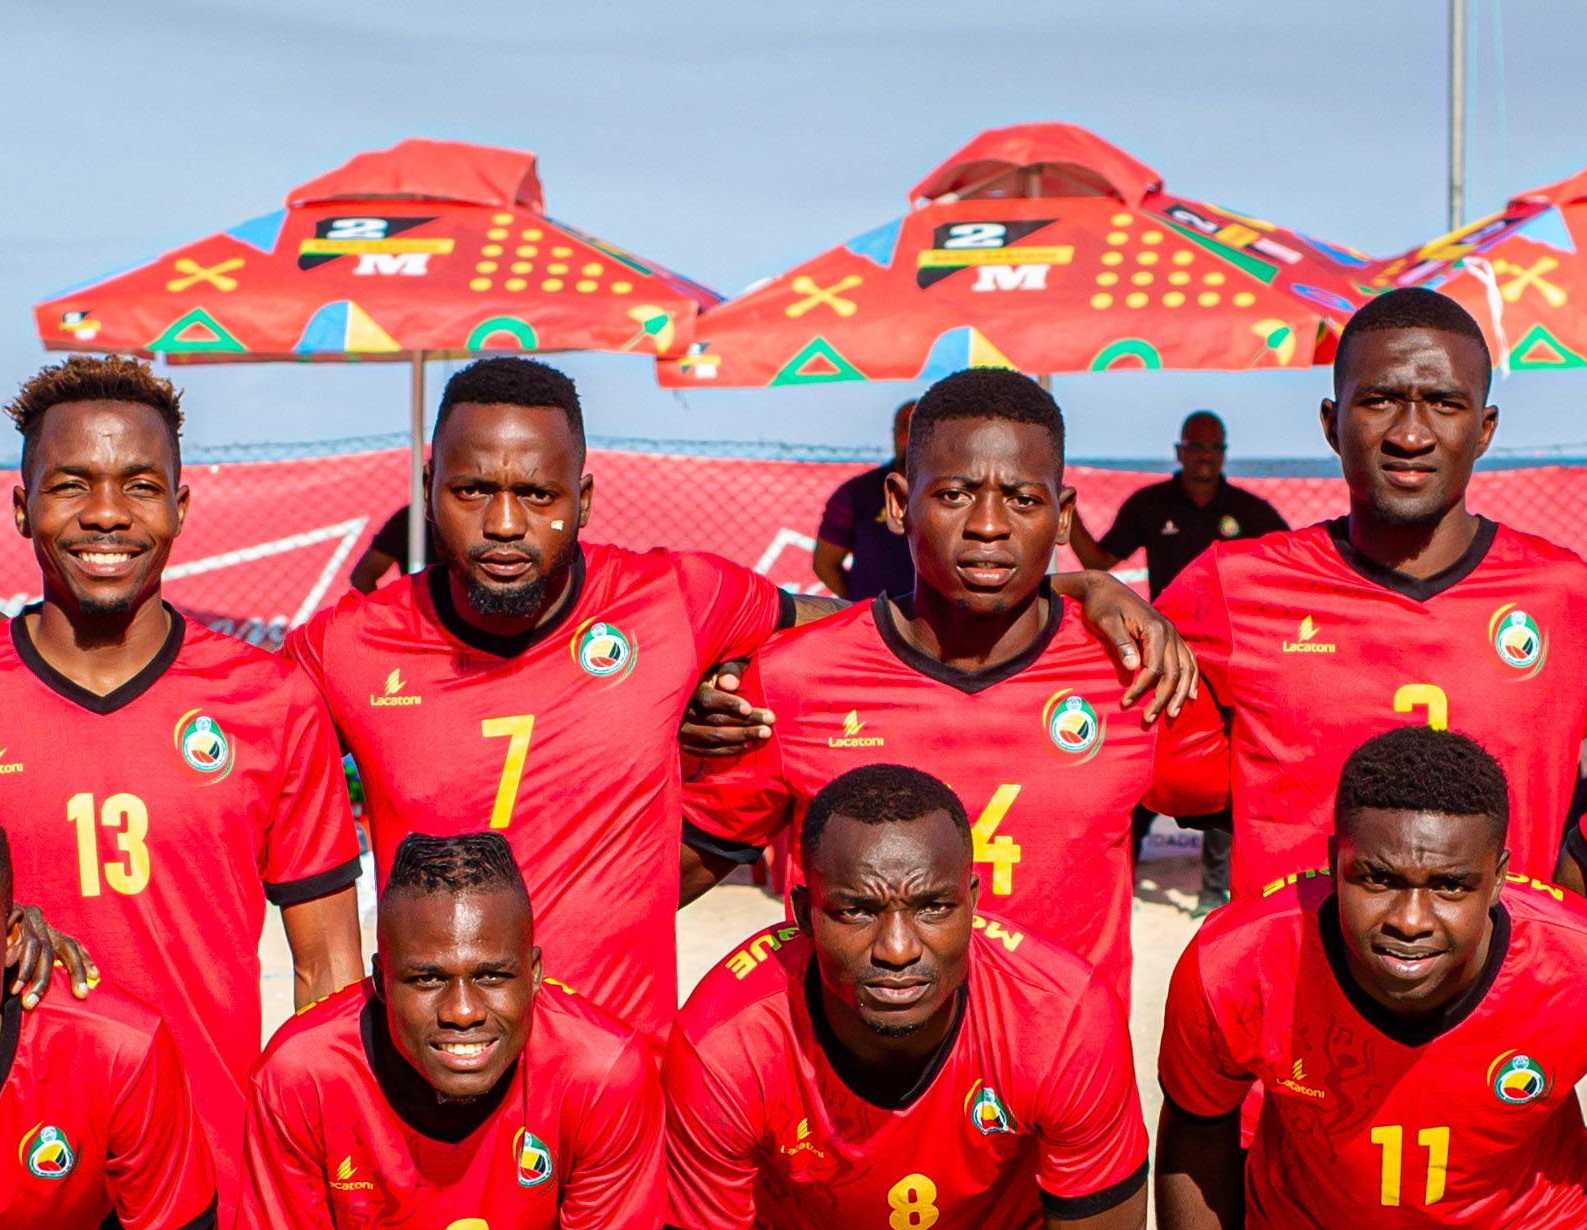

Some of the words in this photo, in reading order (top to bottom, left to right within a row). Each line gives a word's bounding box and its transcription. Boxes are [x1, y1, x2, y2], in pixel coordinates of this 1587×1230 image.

[326, 218, 388, 240] 2
[944, 223, 1006, 249] 2
[353, 253, 431, 276] M
[972, 264, 1051, 291] M
[1282, 641, 1336, 653] Lacatoni
[370, 694, 422, 706] Lacatoni
[829, 736, 884, 748] Lacatoni
[481, 714, 535, 829] 7
[66, 792, 151, 897] 13
[970, 783, 1022, 896] 4
[1276, 1078, 1325, 1098] Lacatoni
[1370, 1125, 1450, 1206] 11
